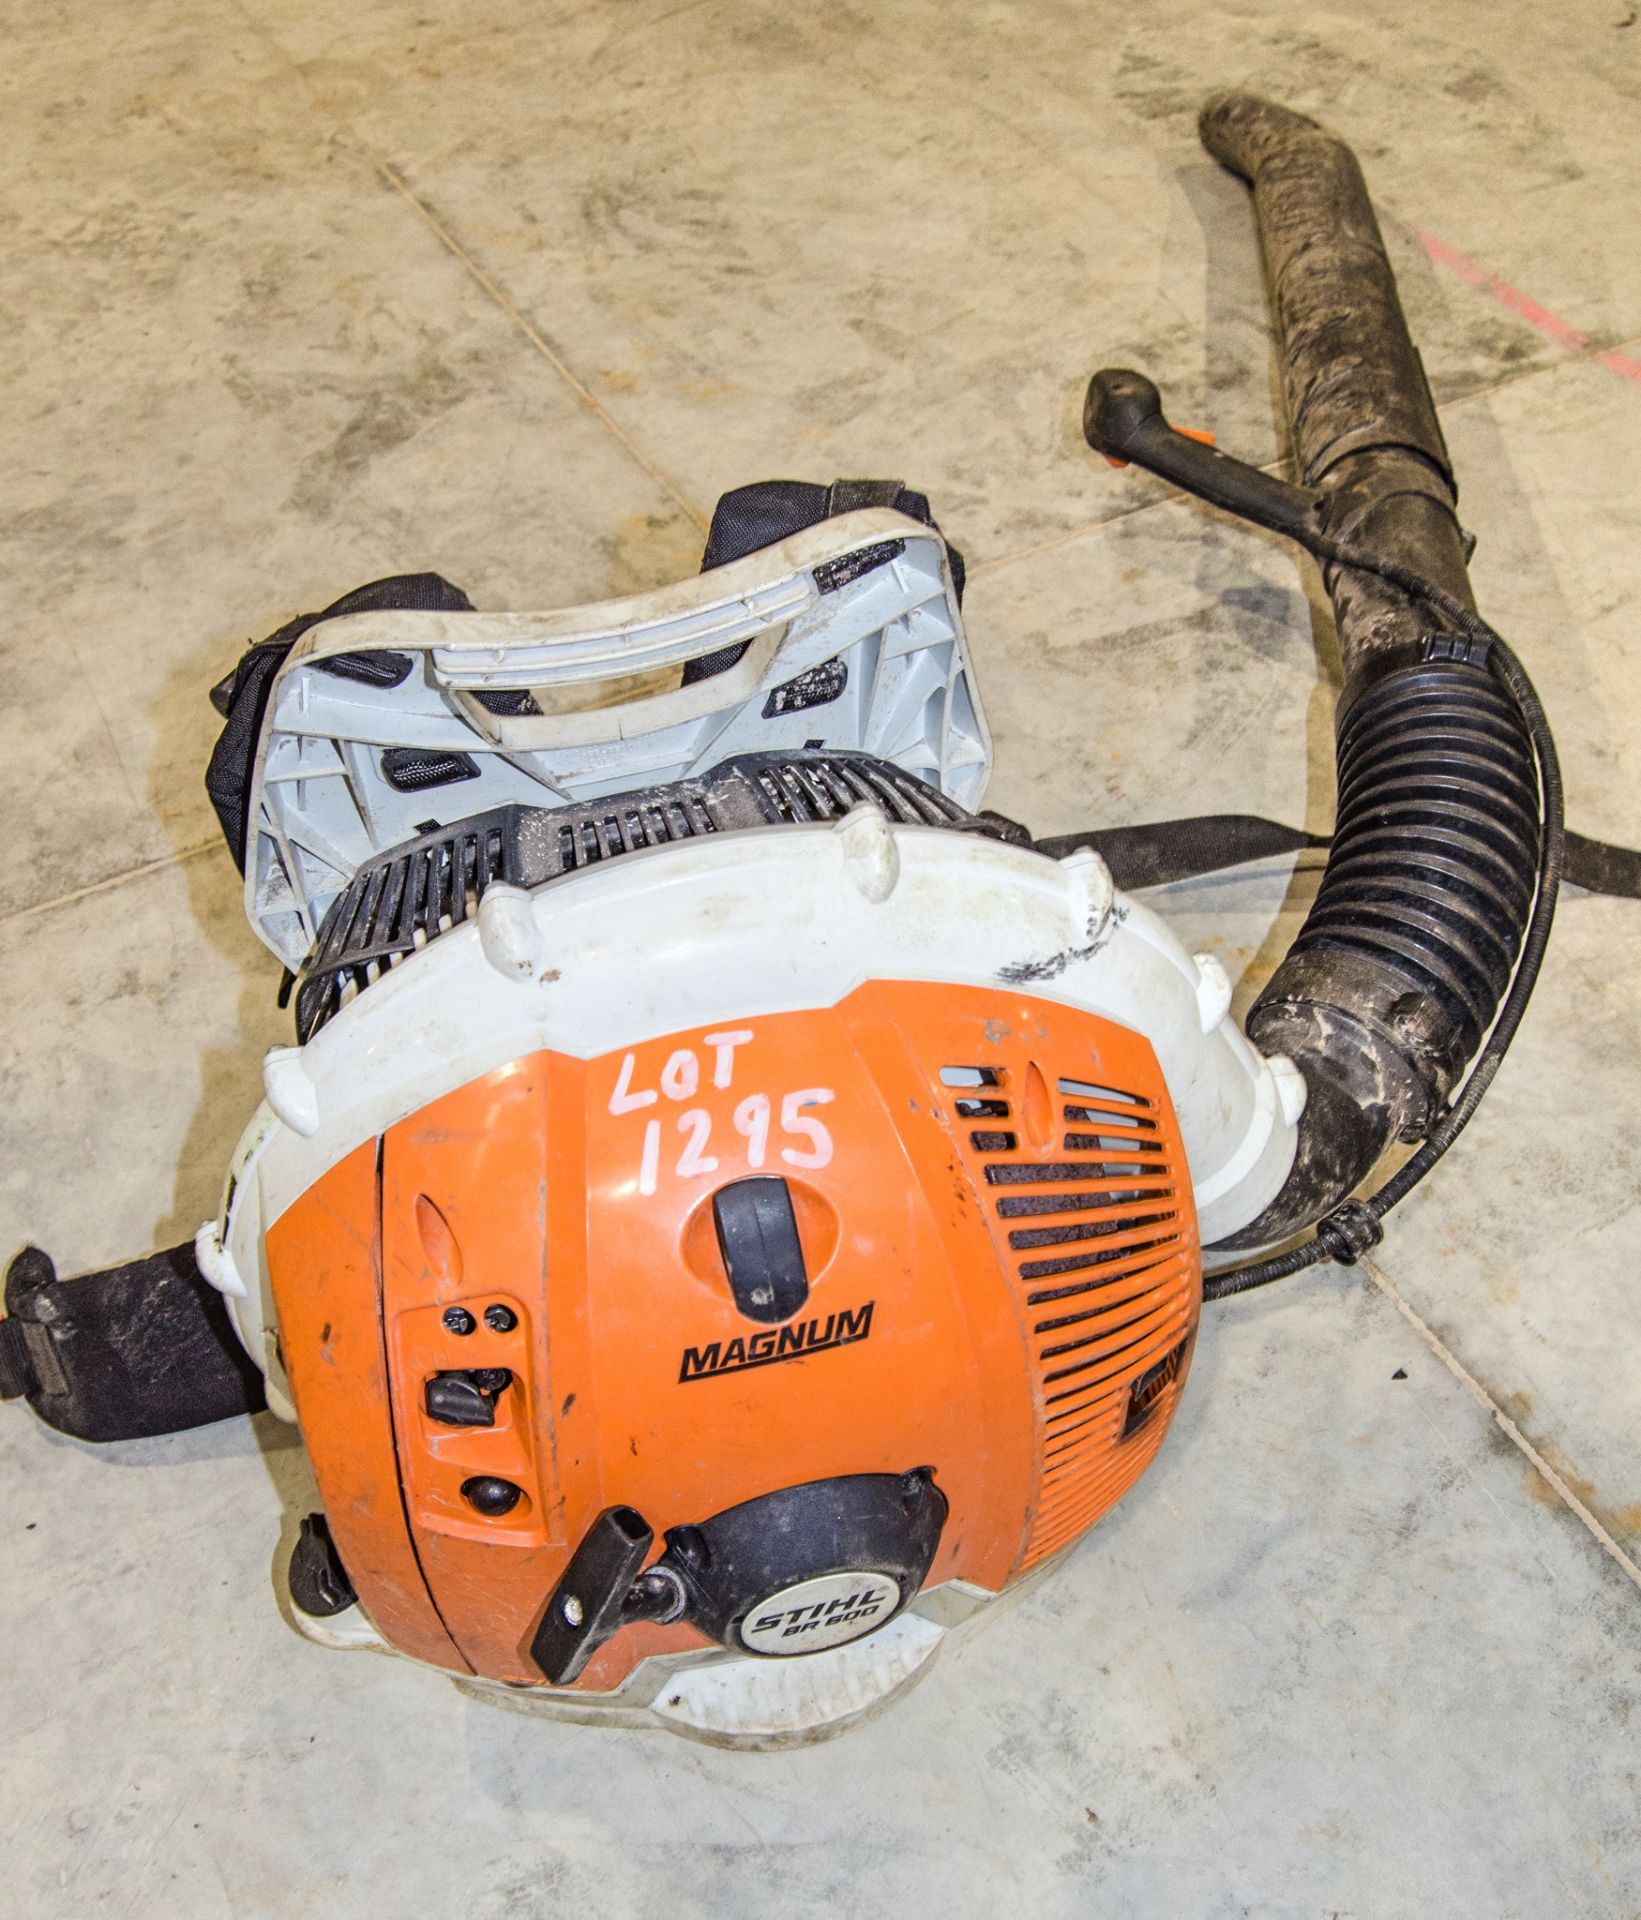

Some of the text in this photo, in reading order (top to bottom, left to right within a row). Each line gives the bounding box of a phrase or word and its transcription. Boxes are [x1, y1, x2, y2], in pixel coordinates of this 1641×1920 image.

[609, 1030, 754, 1115] LOT
[640, 1088, 836, 1195] 1295
[678, 1301, 875, 1383] MAGNUM
[751, 1590, 886, 1633] STIHL
[782, 1605, 880, 1637] BR 600
